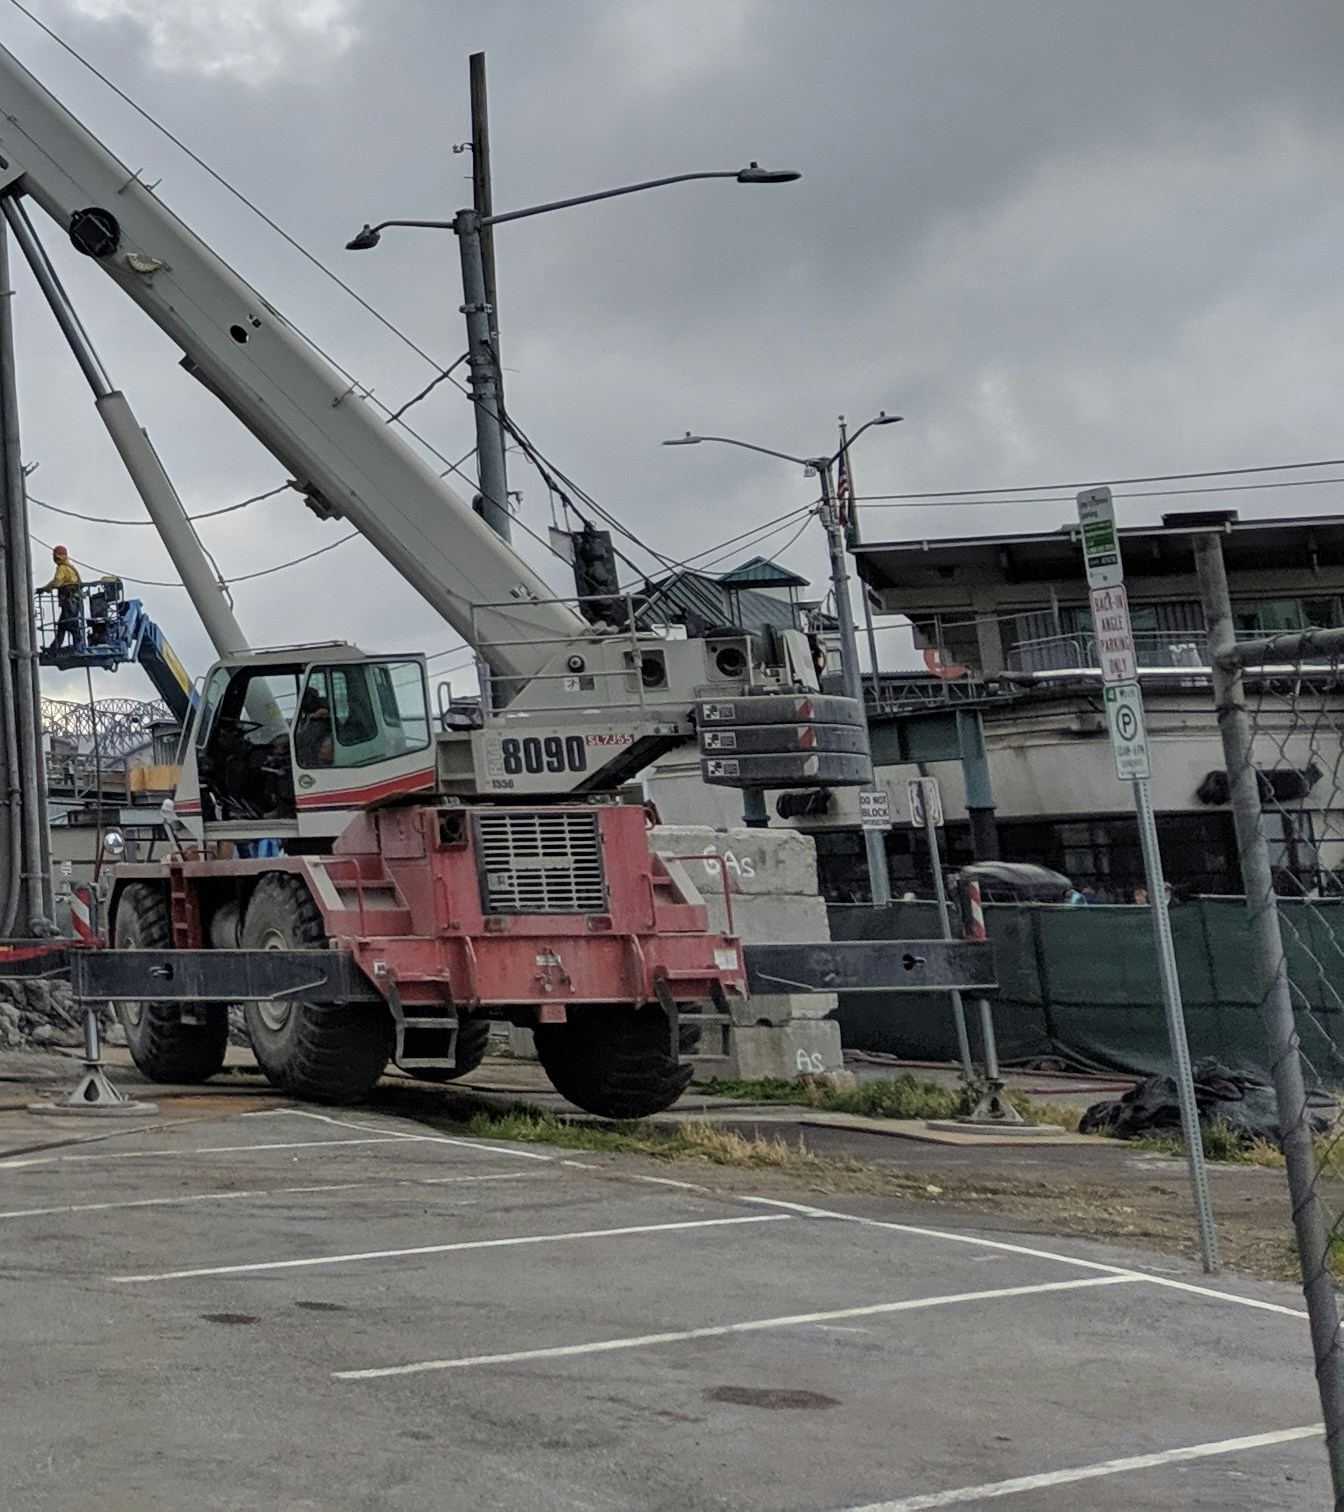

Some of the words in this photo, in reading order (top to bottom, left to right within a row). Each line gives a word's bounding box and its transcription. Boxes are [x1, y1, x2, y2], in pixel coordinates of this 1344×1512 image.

[1094, 594, 1124, 612] BACK-IN
[1101, 615, 1123, 631] ANGLE
[1100, 636, 1131, 653] PARKING
[1110, 658, 1127, 674] ONLY
[1121, 712, 1132, 734] P
[501, 735, 588, 775] 8090
[859, 796, 870, 804] DO
[873, 796, 886, 804] NOT
[862, 808, 888, 817] BLOCK
